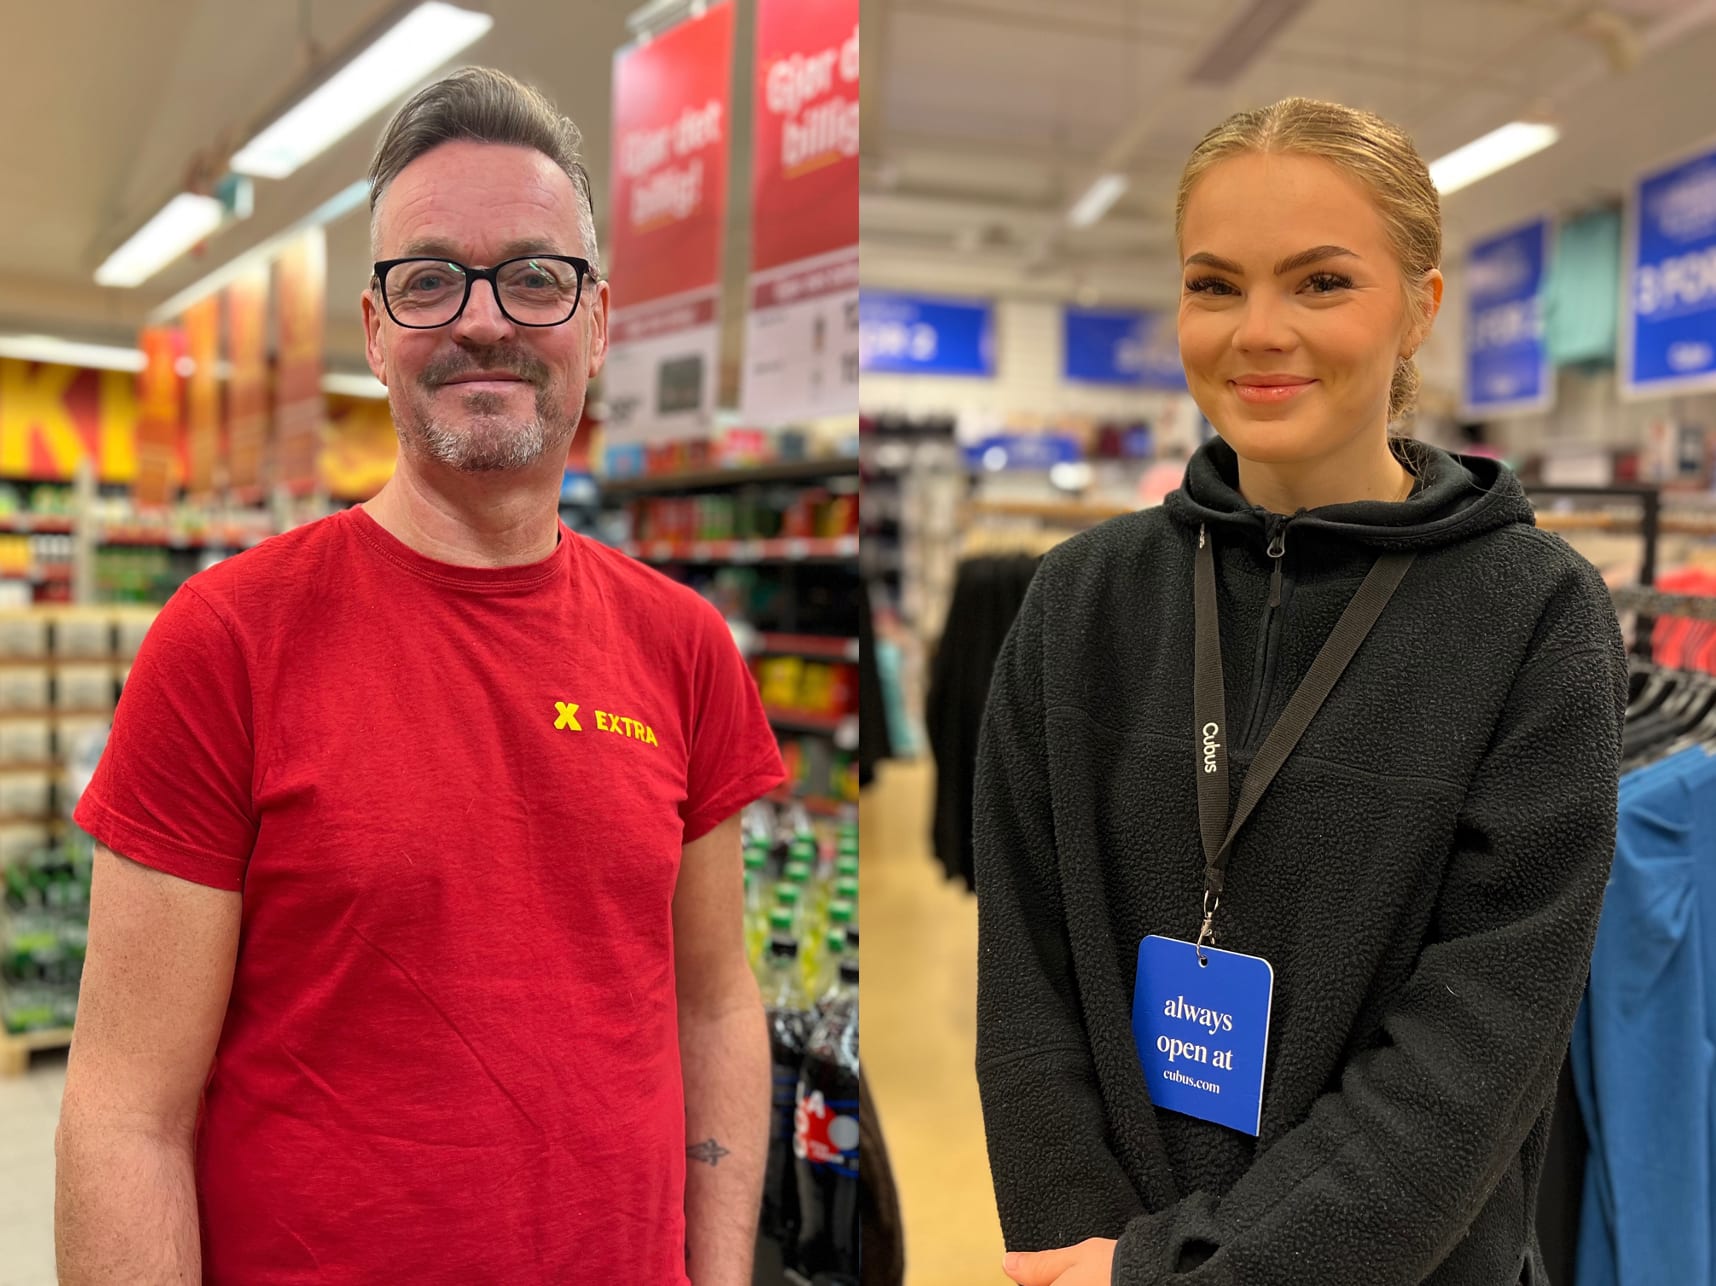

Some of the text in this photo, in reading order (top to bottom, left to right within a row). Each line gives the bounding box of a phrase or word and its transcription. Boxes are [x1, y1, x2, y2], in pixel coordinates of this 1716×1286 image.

[594, 709, 659, 747] EXTRA
[1202, 722, 1221, 774] Cubus
[1163, 995, 1233, 1035] always
[1156, 1034, 1234, 1071] open at
[1163, 1069, 1220, 1095] cubus.com
